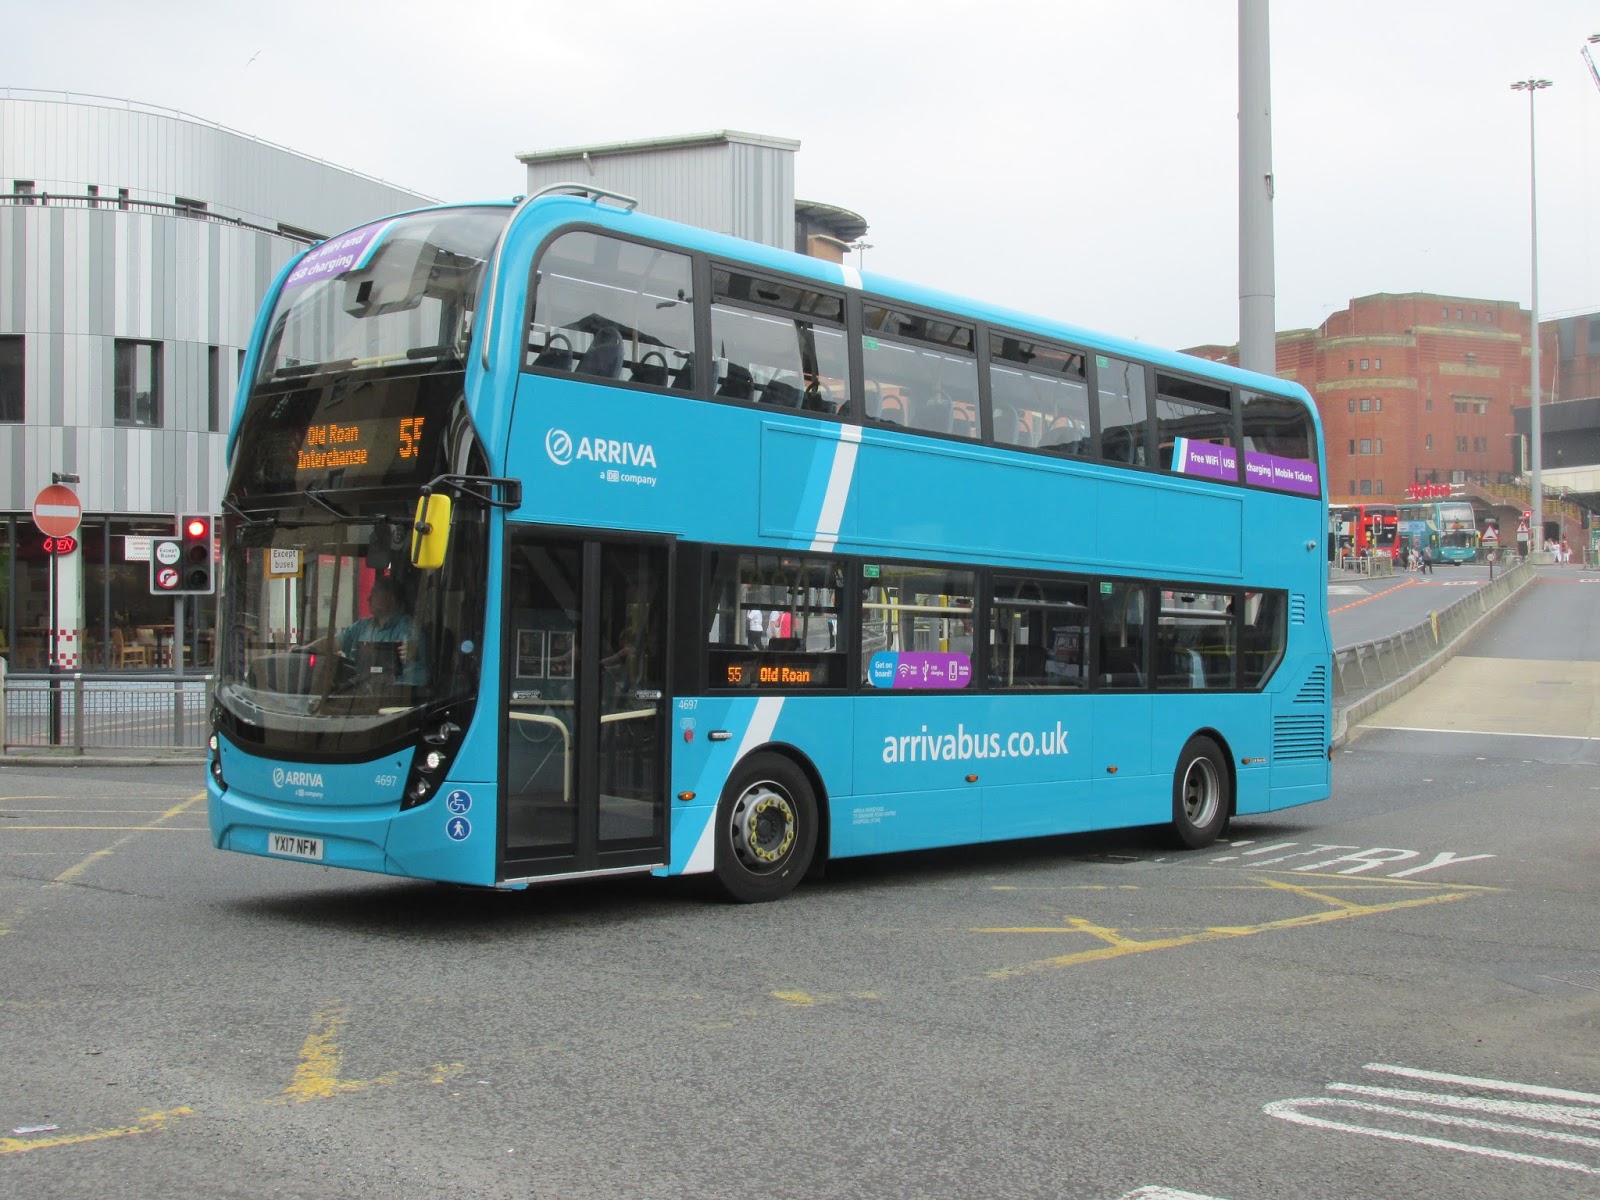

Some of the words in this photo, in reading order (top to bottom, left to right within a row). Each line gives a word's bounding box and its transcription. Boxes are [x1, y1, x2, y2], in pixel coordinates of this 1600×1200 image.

[320, 242, 341, 256] WiFi
[342, 232, 366, 249] and
[288, 268, 308, 283] USB
[307, 254, 354, 273] charging
[308, 426, 326, 445] Old
[330, 424, 359, 443] Roan
[297, 447, 368, 469] Interchange
[576, 437, 657, 468] ARRIVA
[1190, 452, 1204, 463] Free
[1205, 455, 1219, 466] WiFi
[1223, 458, 1236, 469] USB
[1246, 462, 1272, 477] charging
[1274, 467, 1294, 479] Mobile
[1295, 471, 1313, 482] Tickets
[600, 471, 605, 479] a
[620, 473, 656, 486] company
[273, 550, 297, 559] Except
[274, 561, 294, 569] buses
[727, 667, 742, 682] 55
[759, 667, 779, 682] Old
[781, 667, 810, 682] Roan
[678, 699, 698, 709] 4697
[882, 720, 1069, 763] arrivabus.co.uk
[285, 771, 323, 788] ARRIVA
[374, 774, 398, 787] 4697
[275, 835, 295, 853] YX17
[296, 838, 317, 856] NFM
